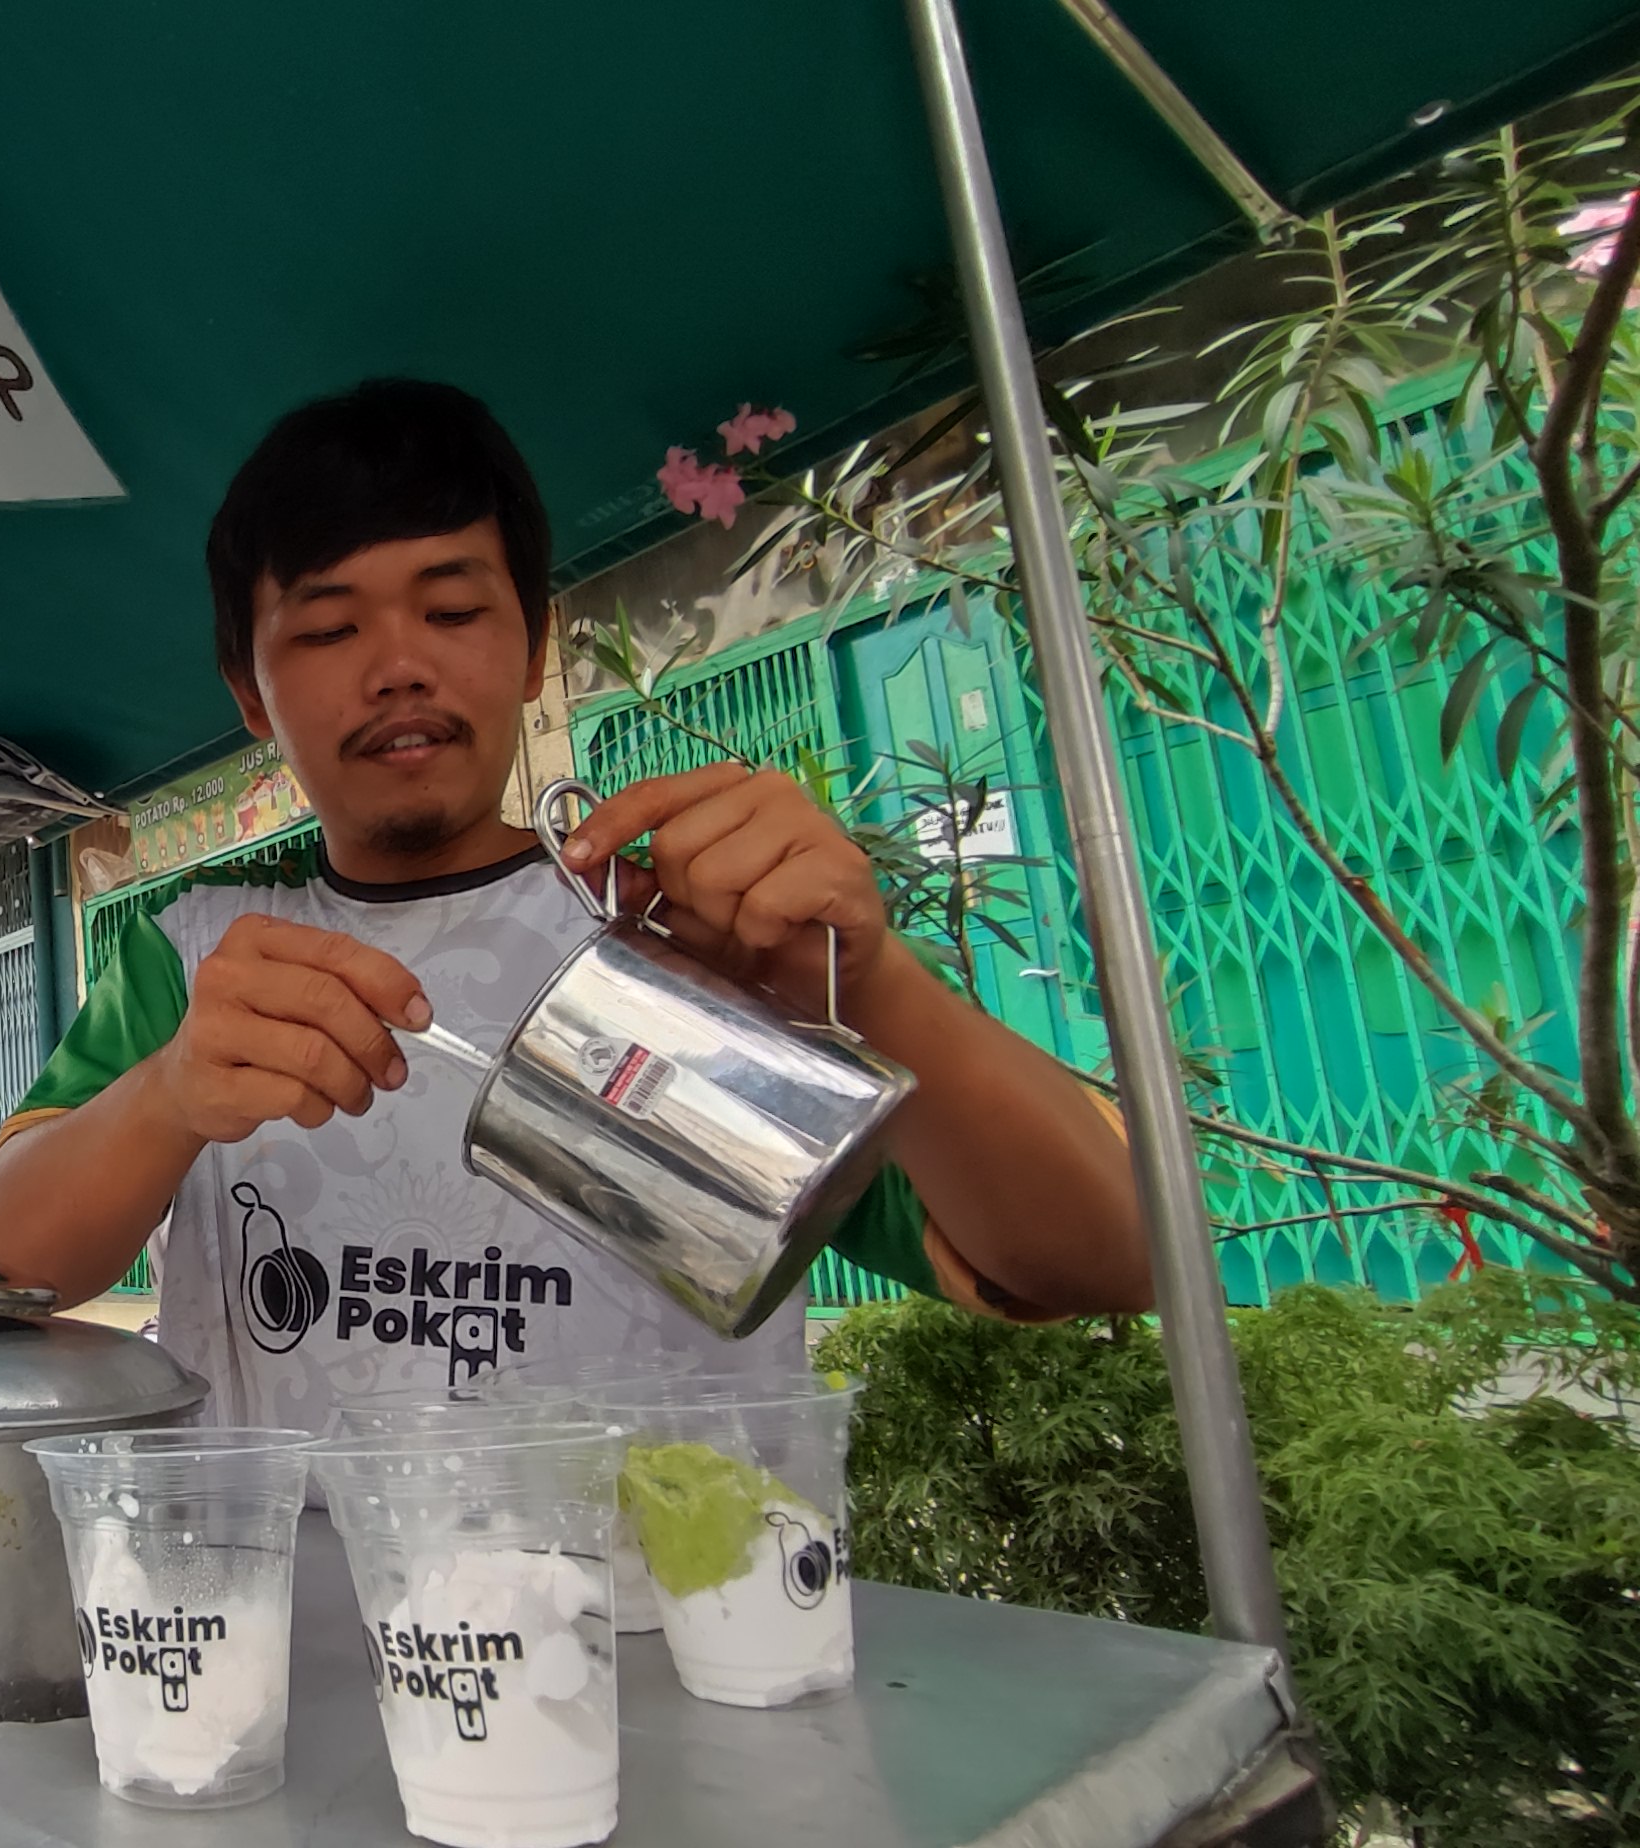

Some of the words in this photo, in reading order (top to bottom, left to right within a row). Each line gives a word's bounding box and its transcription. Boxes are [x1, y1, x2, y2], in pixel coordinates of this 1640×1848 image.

[238, 748, 264, 775] JUS
[135, 801, 171, 830] POTATO
[173, 794, 189, 815] Rp.
[191, 776, 225, 805] 12.000
[340, 1244, 573, 1307] Eskrim
[96, 1606, 226, 1643] Eskrim
[378, 1621, 524, 1663] Eskrim
